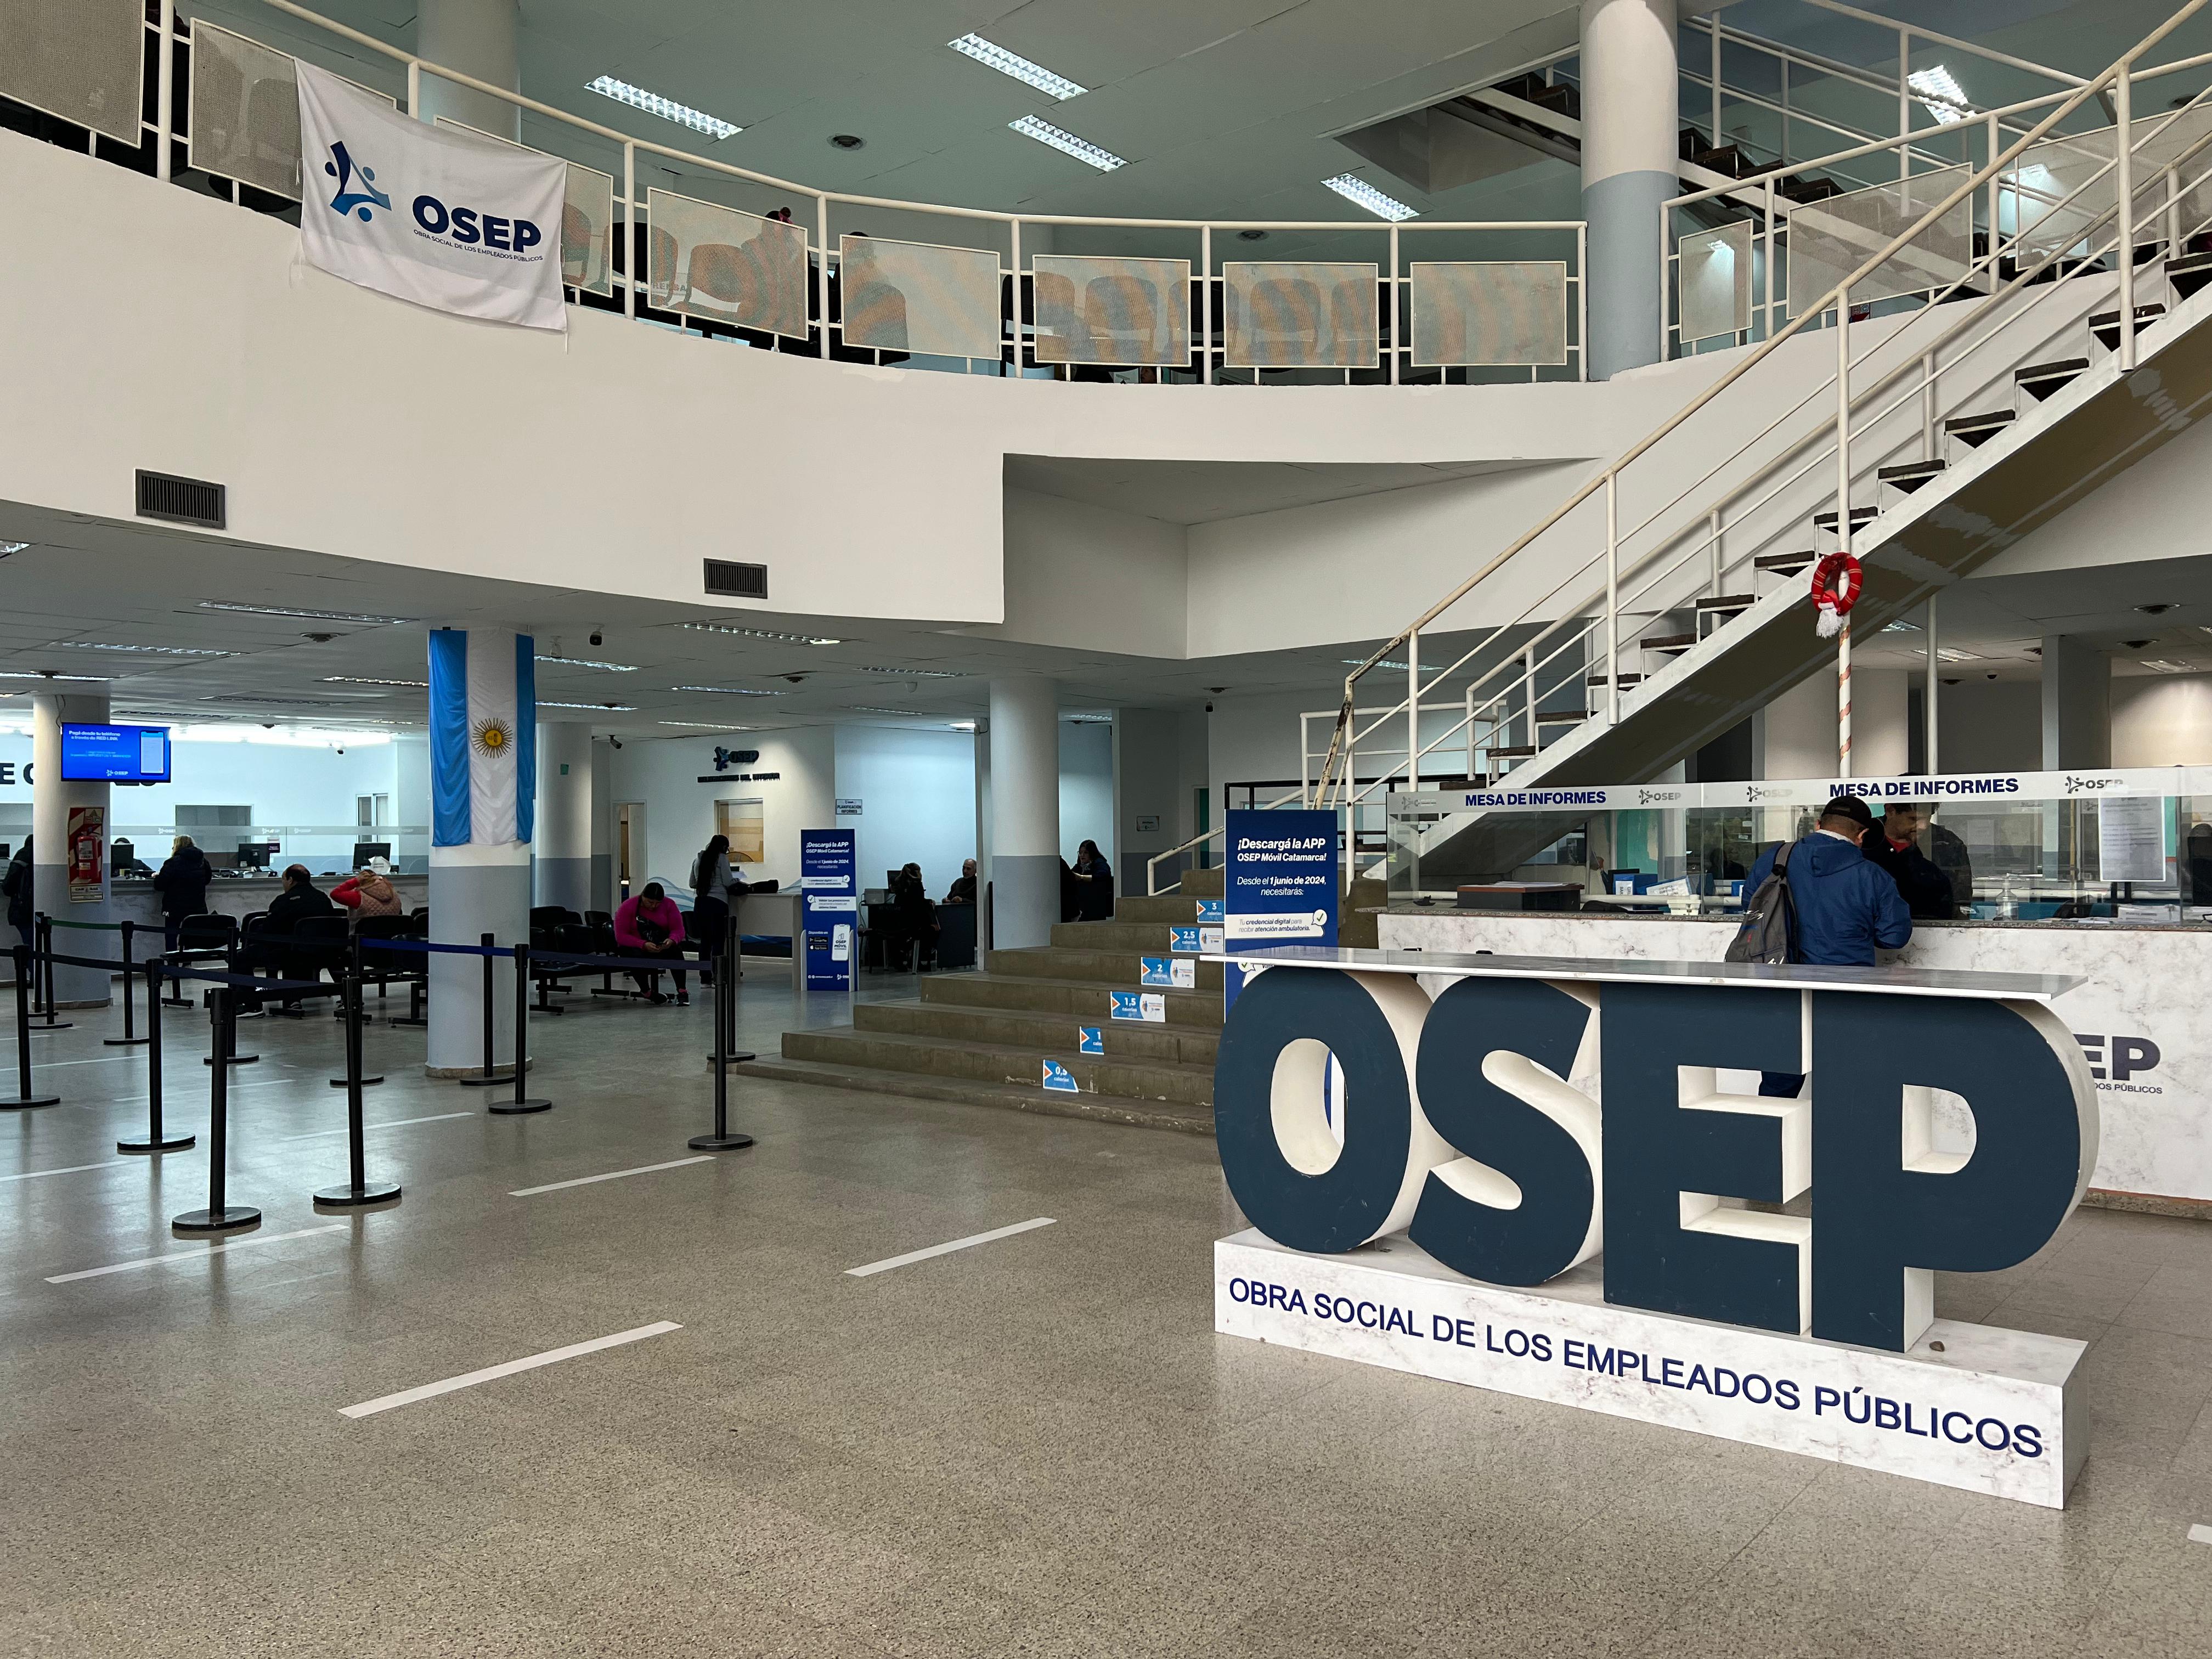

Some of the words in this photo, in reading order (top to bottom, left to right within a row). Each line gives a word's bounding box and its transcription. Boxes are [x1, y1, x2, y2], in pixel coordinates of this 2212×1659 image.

[413, 195, 541, 253] OSEP
[414, 229, 431, 239] OBRA
[432, 236, 453, 247] SOCIAL
[478, 249, 513, 259] EMPLEADOS
[1830, 783, 1882, 797] MESA
[1886, 782, 1910, 795] DE
[1915, 778, 2019, 795] INFORMES
[1465, 794, 1505, 806] MESA
[1508, 793, 1526, 805] DE
[1530, 791, 1606, 805] INFORMES
[1654, 792, 1681, 801] OSEP
[1238, 838, 1291, 851] ¡Descargá
[1292, 838, 1302, 849] la
[1302, 838, 1325, 849] APP
[1237, 853, 1260, 862] OSEP
[1261, 853, 1282, 861] Móvil
[1283, 853, 1327, 861] Catamarca!
[1237, 877, 1261, 885] Desde
[1262, 877, 1269, 885] el
[1273, 877, 1293, 886] junio
[1294, 876, 1304, 884] de
[1305, 876, 1327, 885] 2024,
[1261, 887, 1304, 896] necesitarás:
[1183, 931, 1195, 939] 2,5
[1157, 964, 1163, 972] 2
[1124, 997, 1136, 1006] 1,5
[2114, 1083, 2163, 1094] PÚBLICOS
[1214, 966, 2081, 1353] OSEP
[1229, 1277, 1308, 1315] OBRA
[1314, 1293, 1424, 1338] SOCIAL
[1433, 1314, 1476, 1348] DE
[1486, 1325, 1552, 1362] LOS
[1564, 1339, 1801, 1410] EMPLEADOS
[1815, 1386, 2043, 1458] PÚBLICOS
